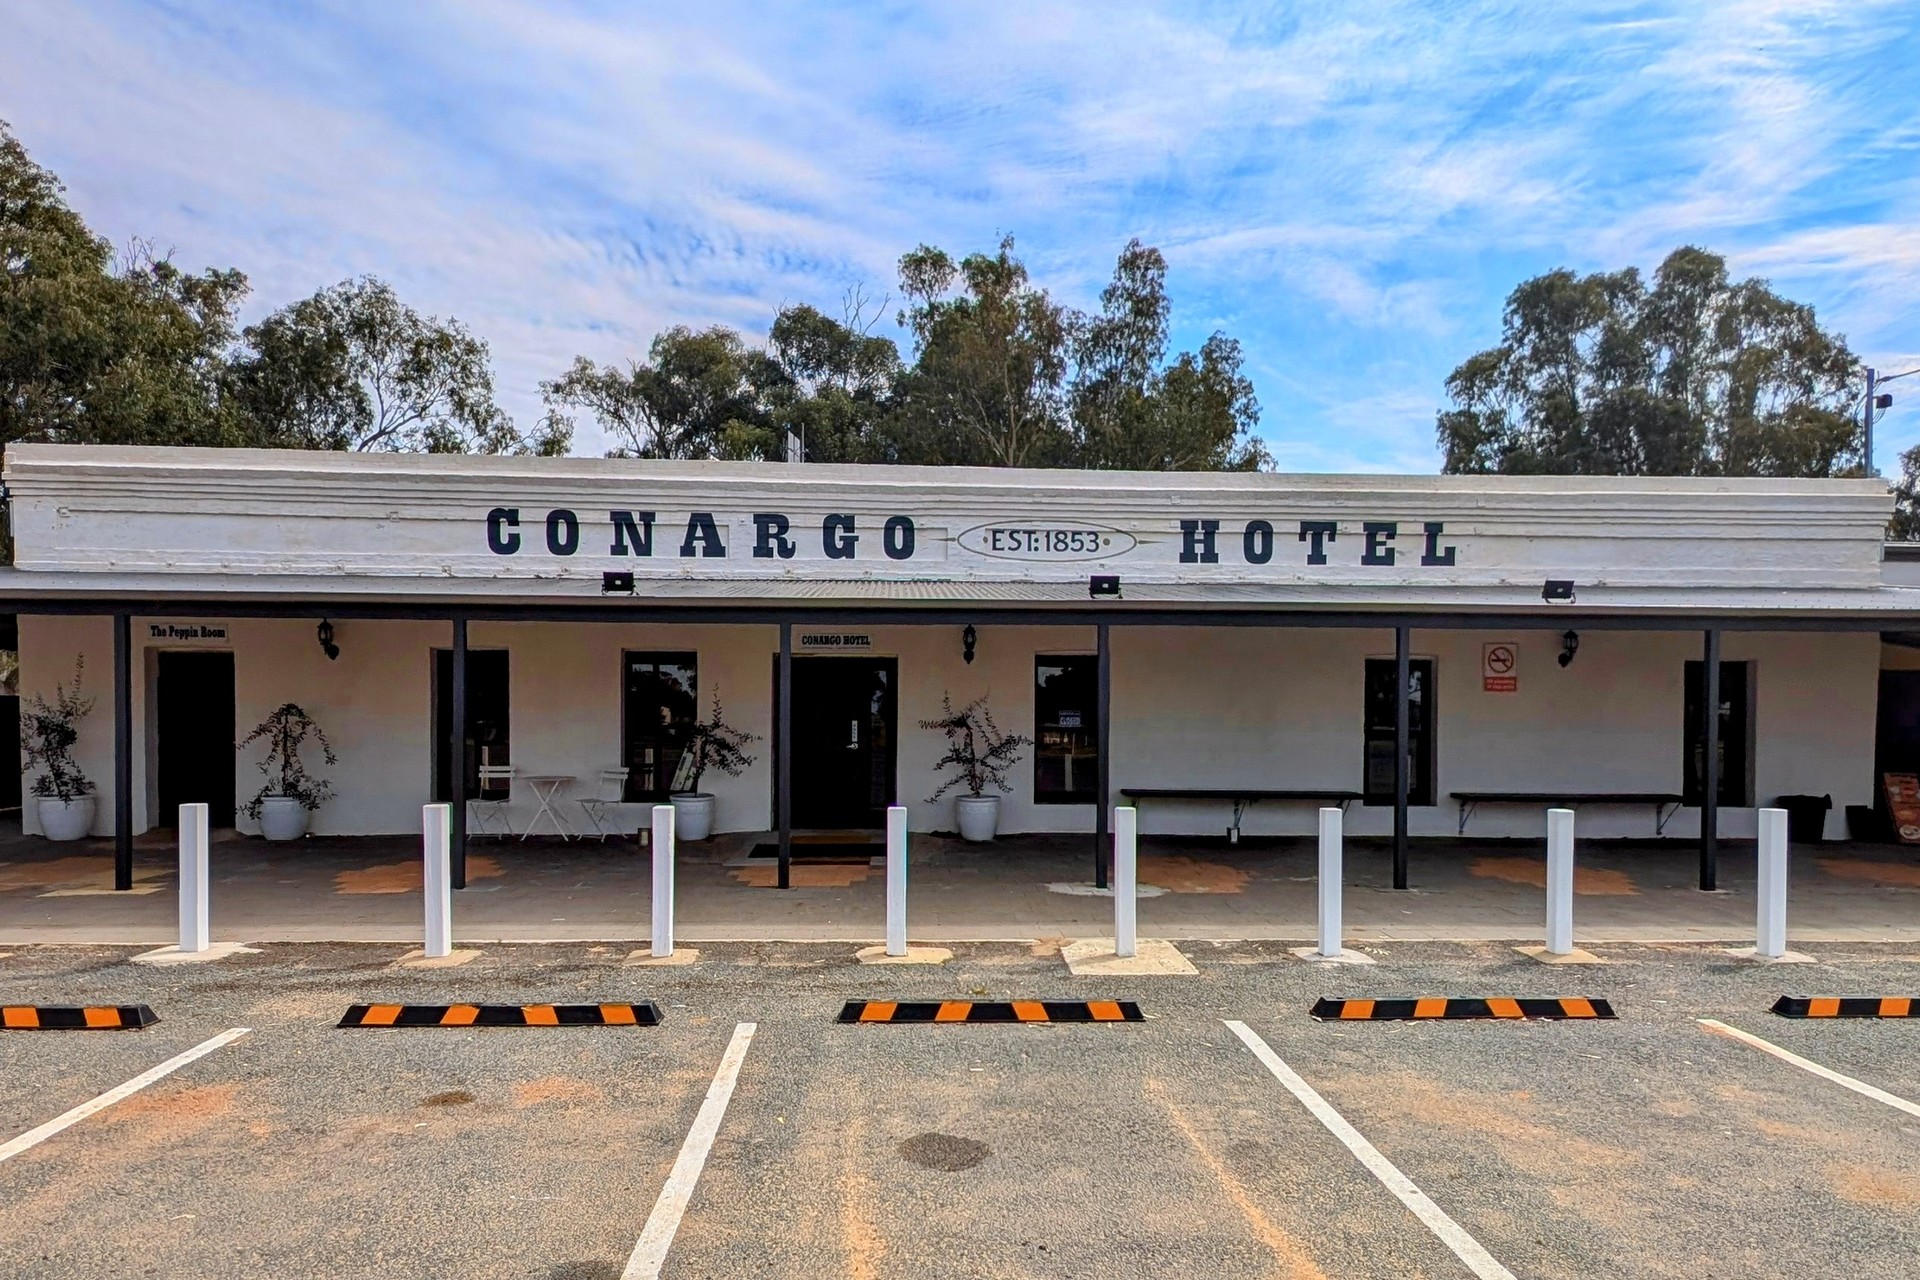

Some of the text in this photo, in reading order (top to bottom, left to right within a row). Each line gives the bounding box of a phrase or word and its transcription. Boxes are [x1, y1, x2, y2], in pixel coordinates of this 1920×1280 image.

[486, 507, 920, 560] CONARGO
[1179, 519, 1457, 567] HOTEL
[150, 625, 226, 640] The Peppin Room
[801, 635, 870, 646] CONARGO HOTEL
